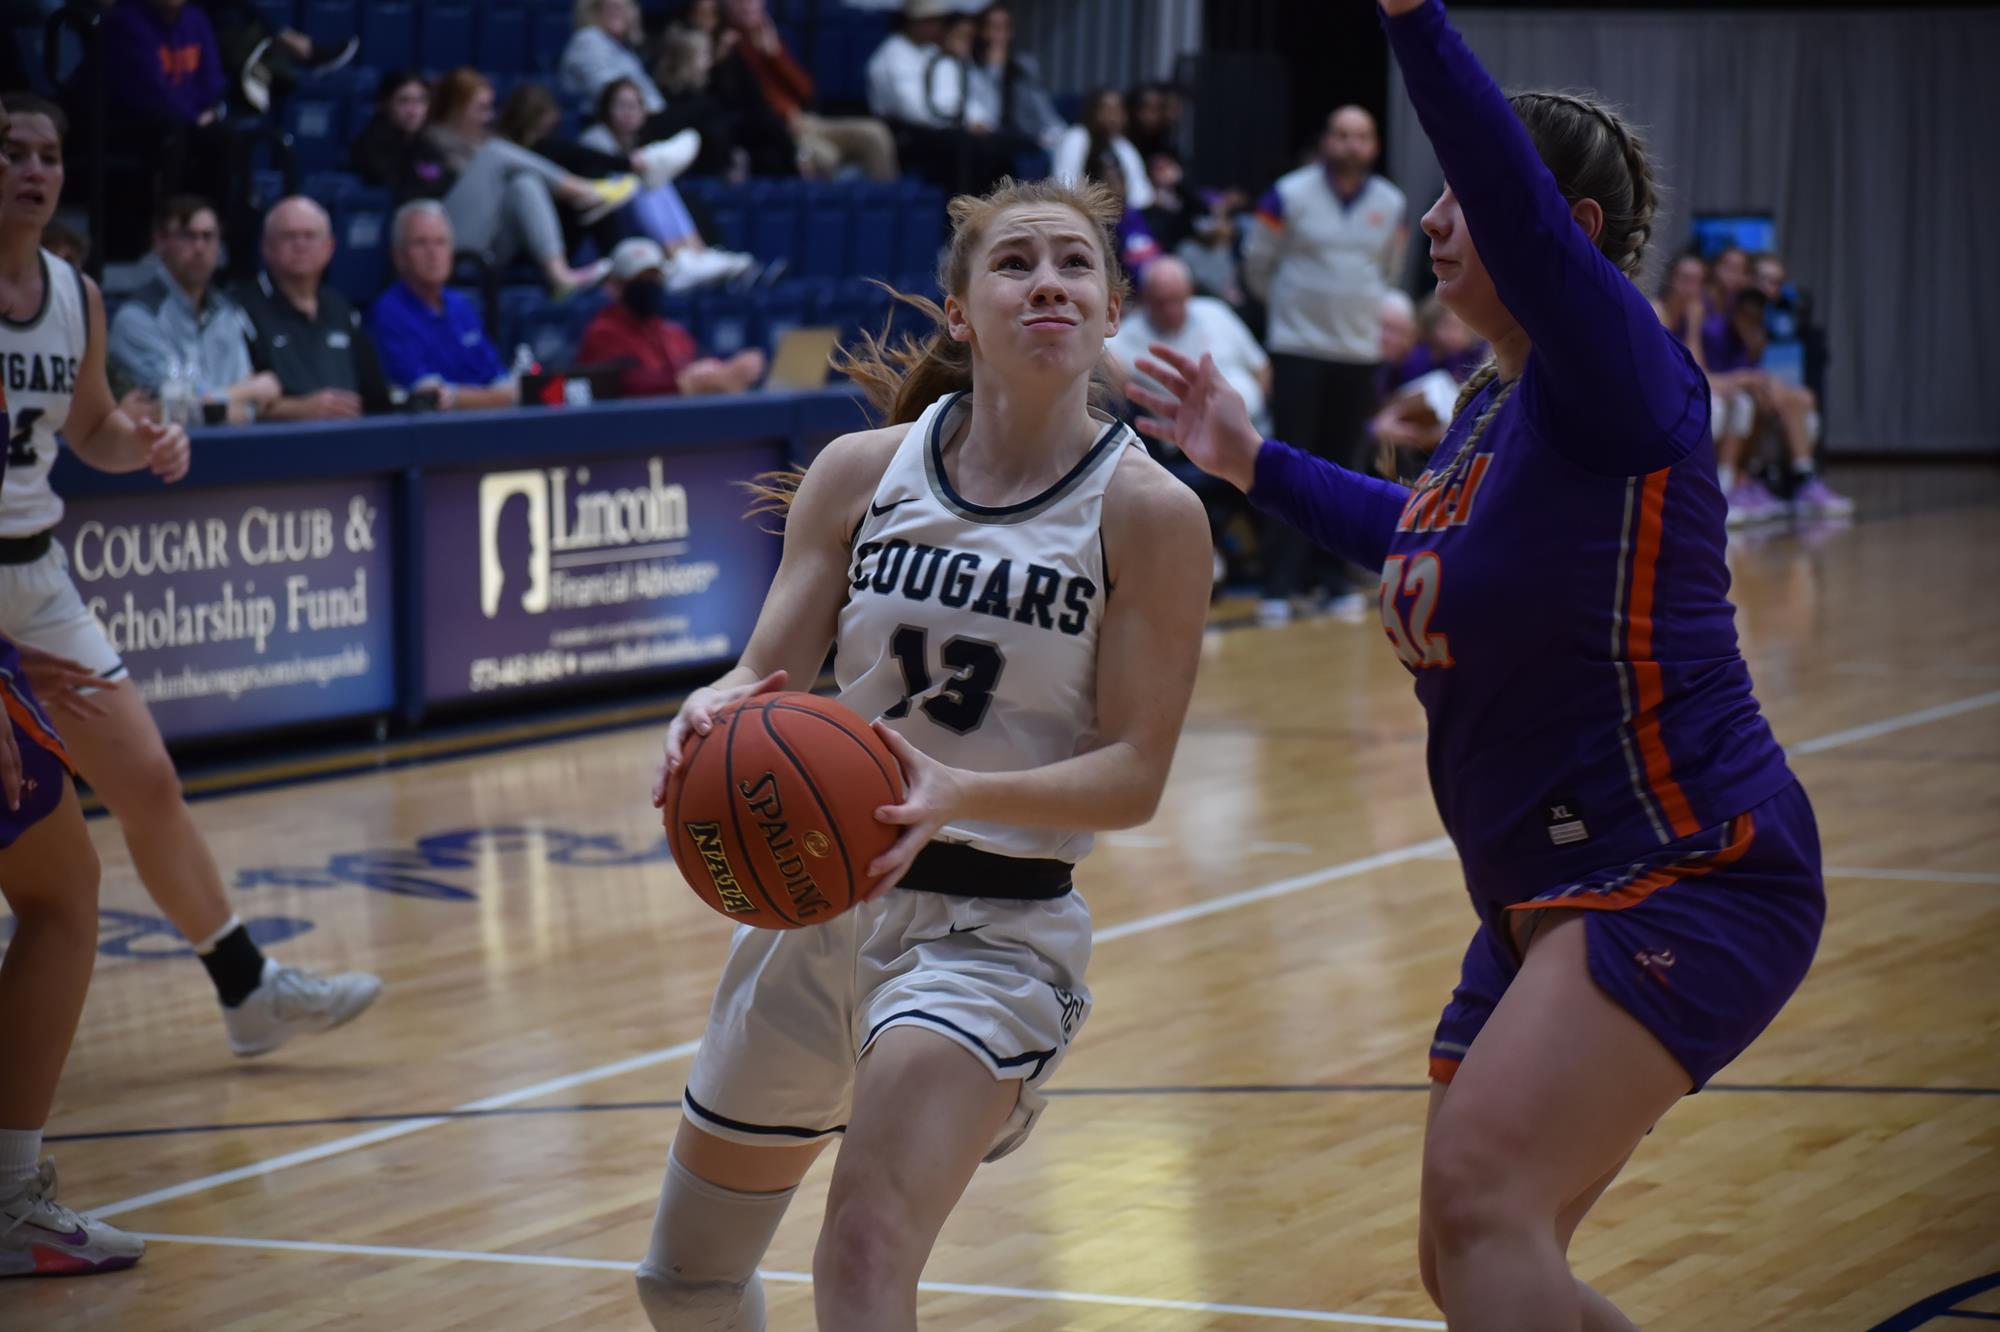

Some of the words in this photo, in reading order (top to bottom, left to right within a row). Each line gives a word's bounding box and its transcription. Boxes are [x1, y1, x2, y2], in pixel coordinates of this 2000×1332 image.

[239, 506, 334, 565] CLUB
[345, 495, 376, 552] &
[551, 457, 689, 549] Lincoln
[287, 566, 367, 632] Fund
[853, 538, 1097, 636] COUGARS
[881, 623, 1007, 737] 13
[739, 771, 832, 917] SPALDING
[1551, 804, 1573, 819] XL
[685, 820, 760, 914] NAIA
